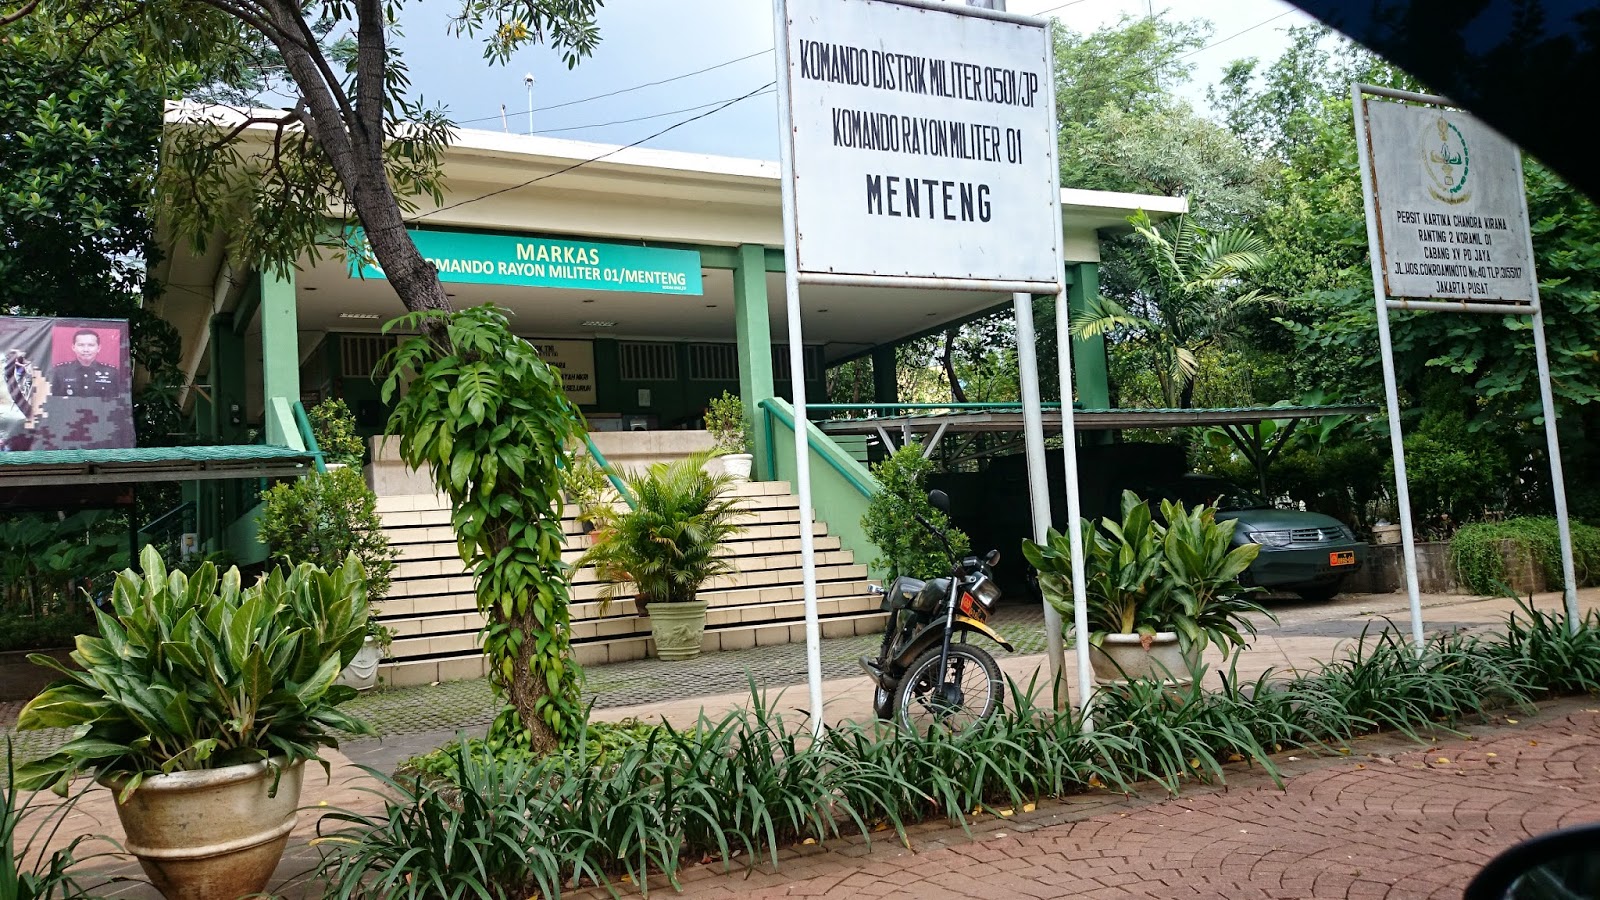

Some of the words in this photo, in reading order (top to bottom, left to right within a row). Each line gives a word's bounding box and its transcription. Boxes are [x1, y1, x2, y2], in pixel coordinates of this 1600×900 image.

[799, 39, 870, 87] KOMANDO
[872, 51, 926, 95] DISTRIK
[929, 57, 982, 102] MILITER
[984, 66, 1038, 108] 0501/JP
[832, 107, 899, 152] KOMANDO
[902, 116, 948, 156] RAYON
[949, 121, 1001, 162] MILITER
[1006, 128, 1023, 164] 01
[866, 174, 992, 223] MENTENG
[1396, 210, 1420, 225] PERSIT
[1423, 213, 1452, 227] KARTIKA
[1453, 215, 1483, 229] CHANDRA
[1483, 217, 1507, 230] KIRANA
[1418, 229, 1447, 243] RANTING
[1449, 231, 1454, 243] 2
[1456, 232, 1483, 246] KORAMIL
[1484, 233, 1492, 246] 01
[516, 243, 600, 266] MARKAS
[1423, 246, 1450, 260] CABANG
[1452, 248, 1460, 261] XV
[1474, 249, 1491, 262] JAYA
[424, 258, 494, 275] MANDO
[498, 261, 545, 278] RAYON
[549, 264, 602, 281] MILITER
[603, 268, 686, 286] 01/MENTENG
[1436, 280, 1466, 294] JAKARTA
[1467, 282, 1489, 295] PUSAT
